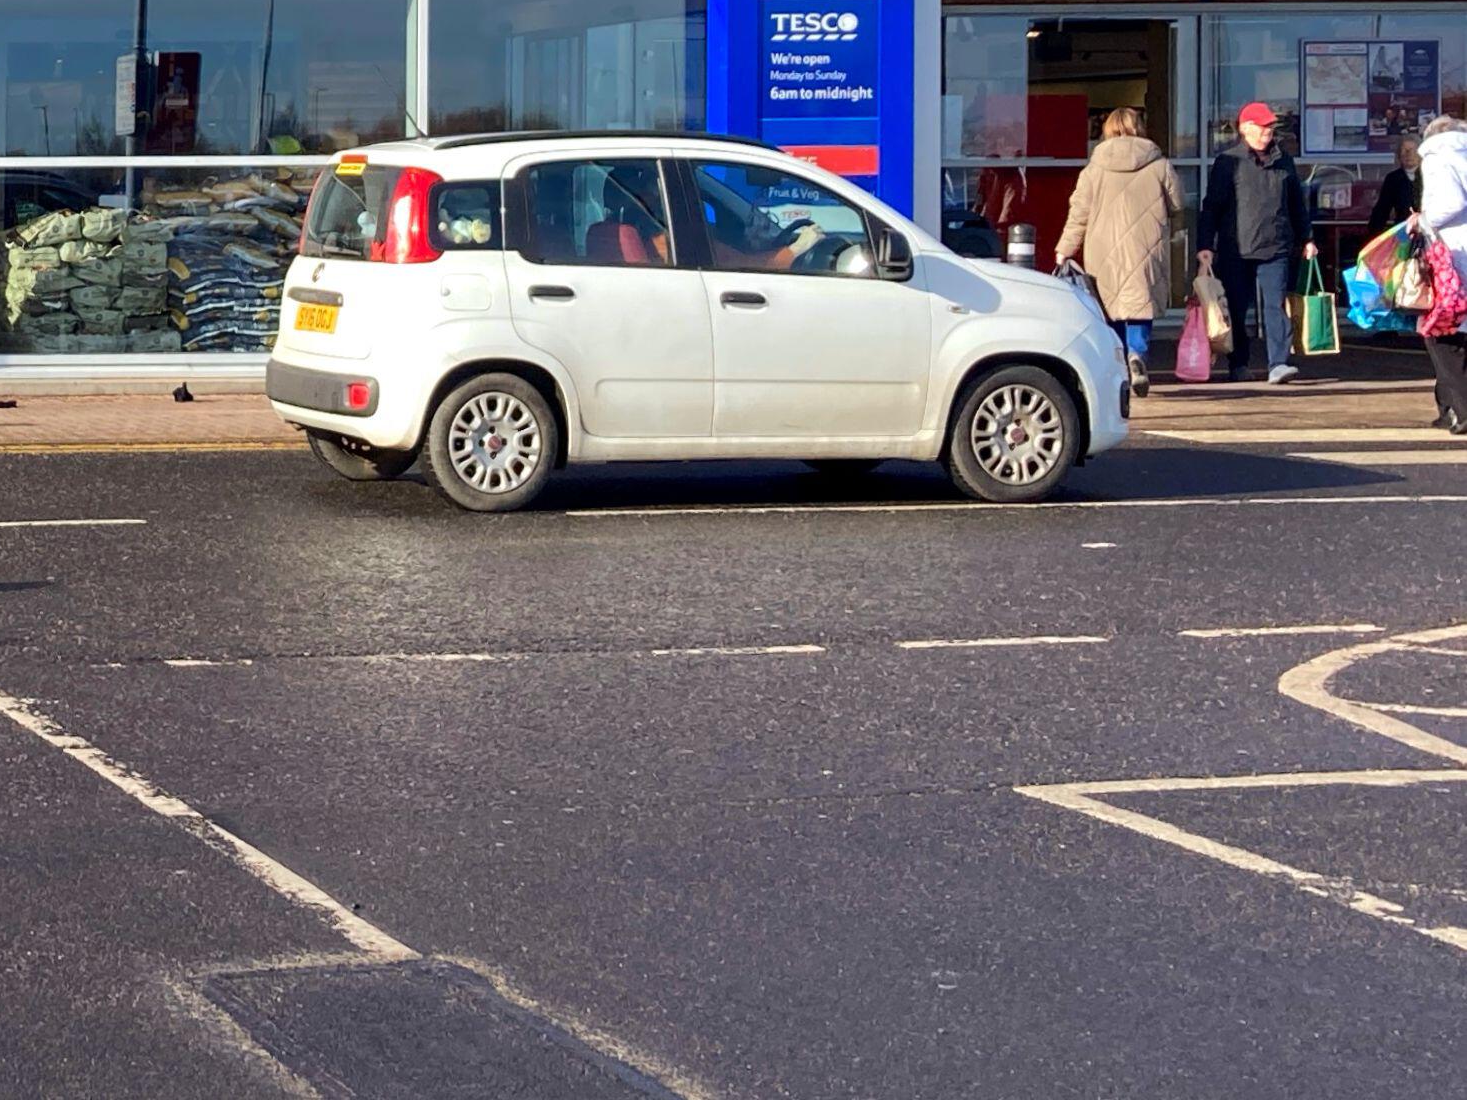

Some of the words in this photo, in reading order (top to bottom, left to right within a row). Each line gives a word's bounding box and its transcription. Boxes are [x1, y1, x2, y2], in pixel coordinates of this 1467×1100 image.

[770, 12, 858, 32] TESCO
[770, 53, 802, 65] We're
[803, 55, 831, 67] open
[770, 70, 804, 82] Monday
[805, 72, 814, 80] to
[815, 69, 847, 82] Sunday
[770, 86, 798, 99] 6am
[800, 87, 813, 99] to
[814, 86, 873, 102] midnight
[801, 188, 820, 201] Veg
